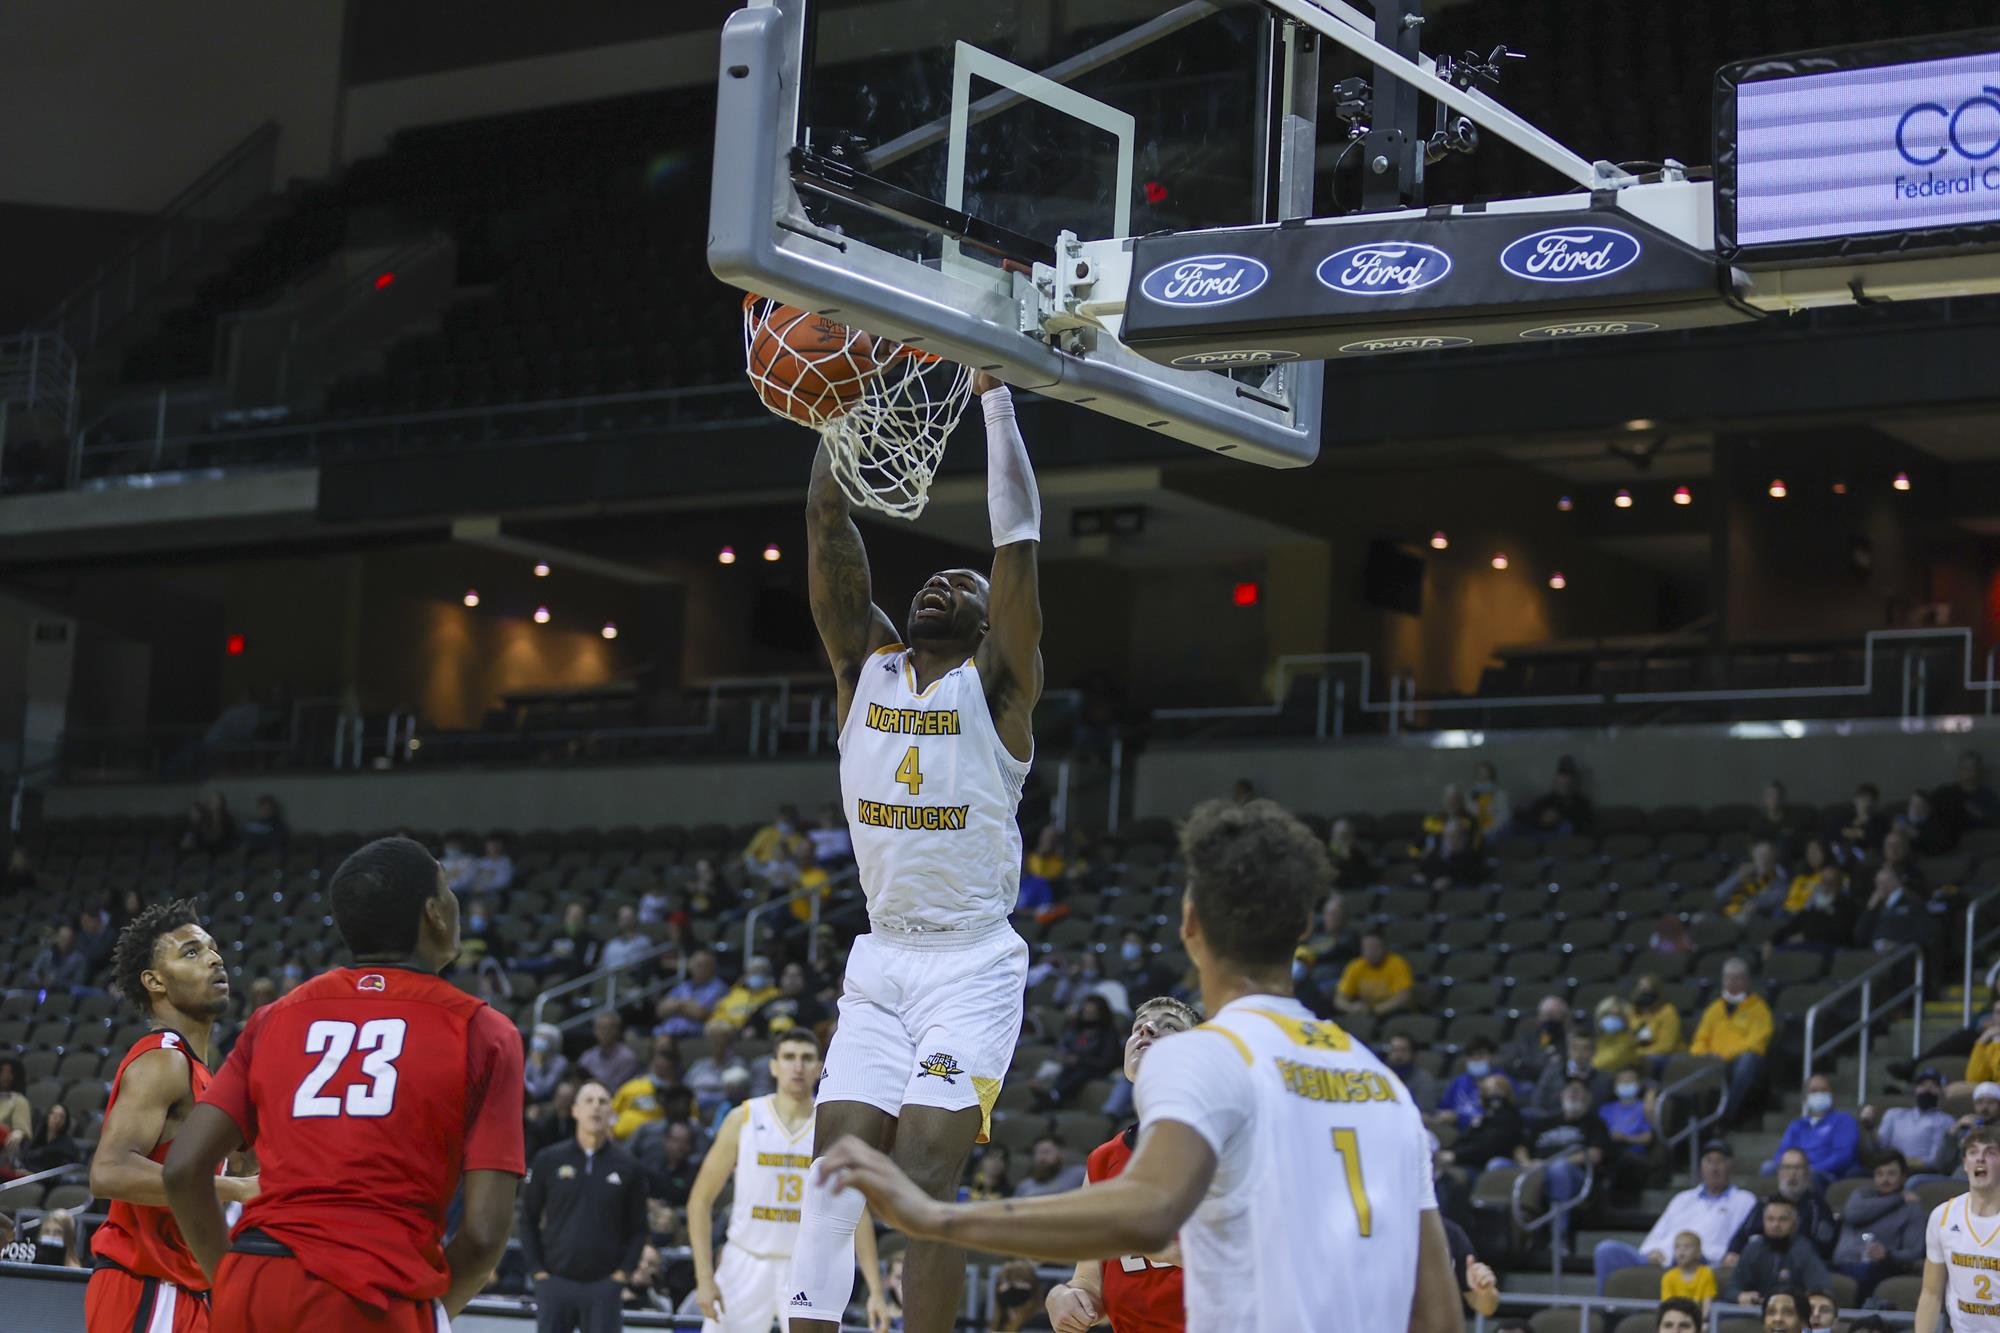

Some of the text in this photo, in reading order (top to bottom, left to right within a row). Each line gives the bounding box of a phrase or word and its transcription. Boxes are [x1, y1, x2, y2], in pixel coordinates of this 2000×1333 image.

[1895, 166, 1976, 200] Federal
[1340, 249, 1426, 287] Ford
[1525, 234, 1615, 273] Ford
[1164, 262, 1245, 299] Ford
[1362, 338, 1444, 351] Ford
[1545, 323, 1629, 337] Ford
[1194, 351, 1273, 364] Ford
[895, 746, 923, 795] 4
[858, 799, 969, 830] KENTUCKY
[292, 1018, 407, 1118] 23
[776, 1173, 804, 1203] 13
[1331, 1126, 1372, 1238] 1
[1973, 1274, 1992, 1300] 2
